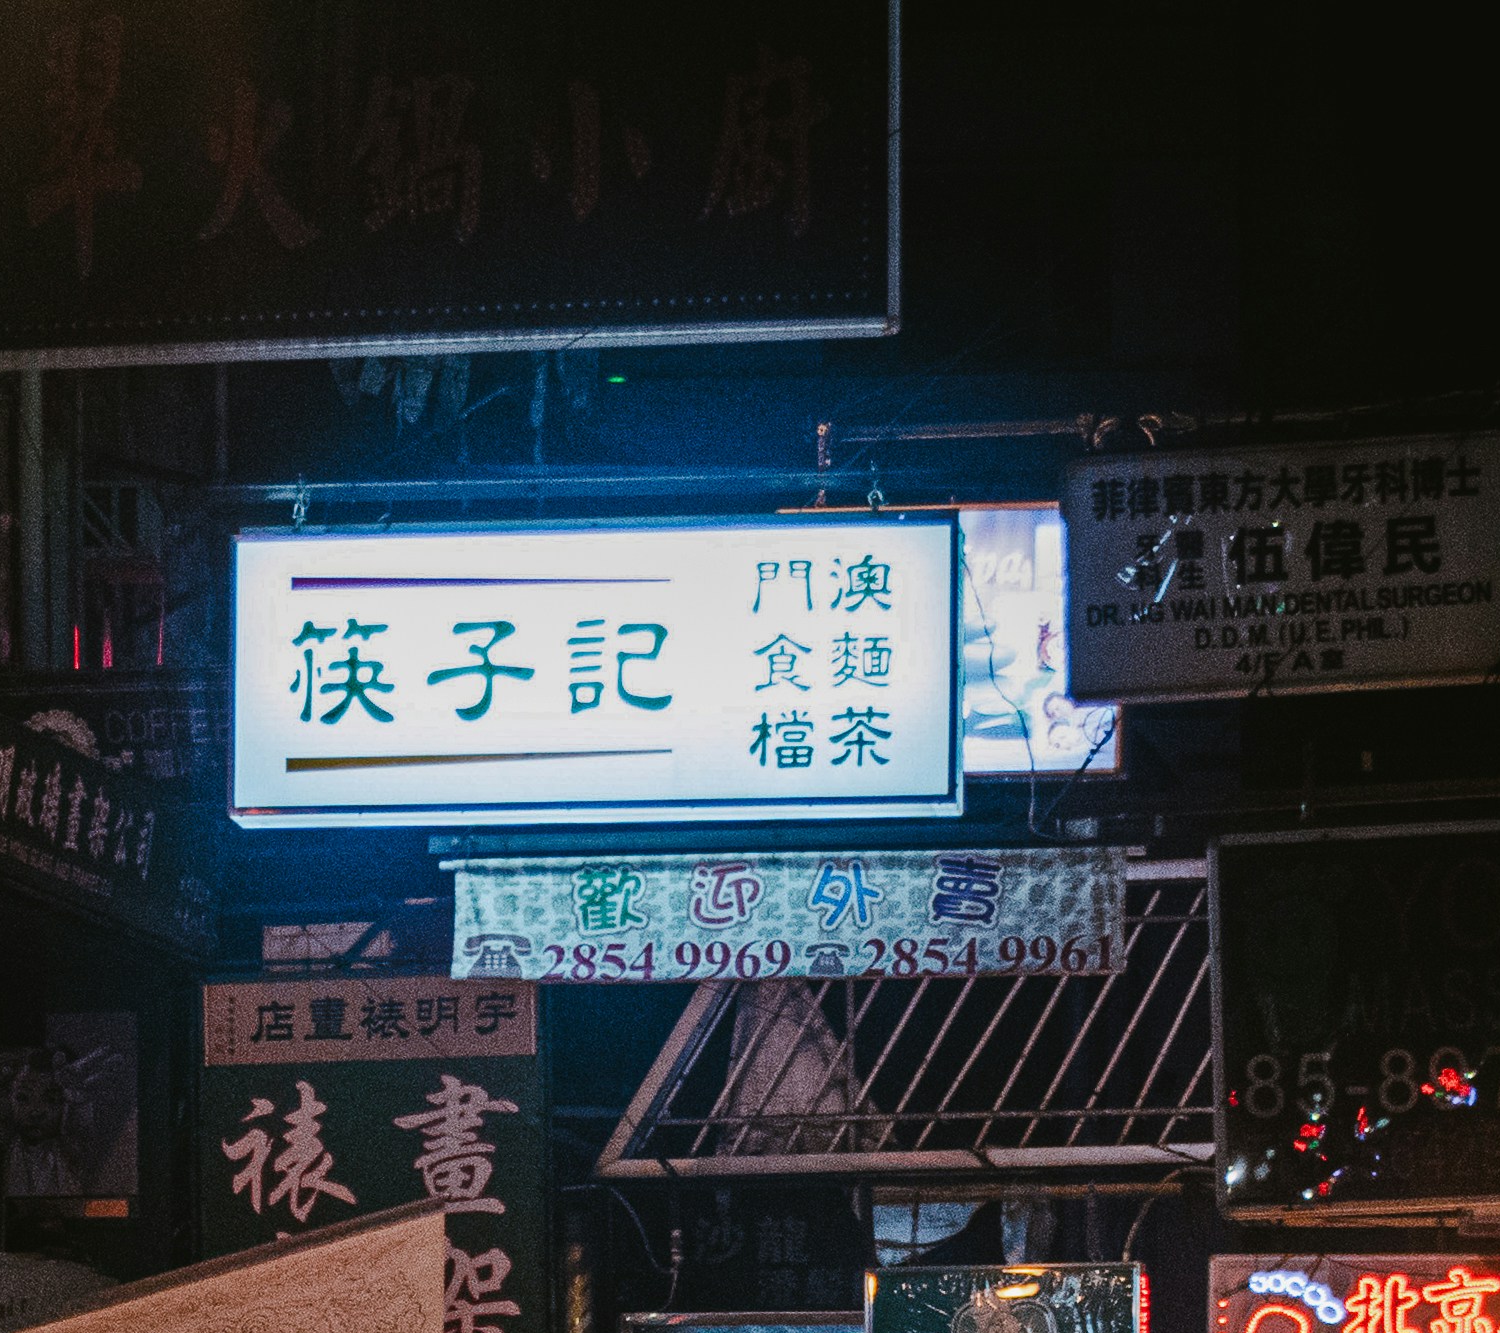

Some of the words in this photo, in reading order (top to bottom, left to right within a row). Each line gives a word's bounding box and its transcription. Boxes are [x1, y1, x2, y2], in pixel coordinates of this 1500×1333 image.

[1092, 456, 1481, 521] 菲律賓東方大學牙科博士
[1229, 515, 1442, 585] 伍偉民
[289, 617, 674, 726] 筷子記
[571, 855, 1002, 936] 歡迎外賣
[543, 940, 655, 981] 2854
[674, 940, 792, 980] 9969
[862, 937, 979, 978] 2854
[1000, 936, 1113, 975] 9961
